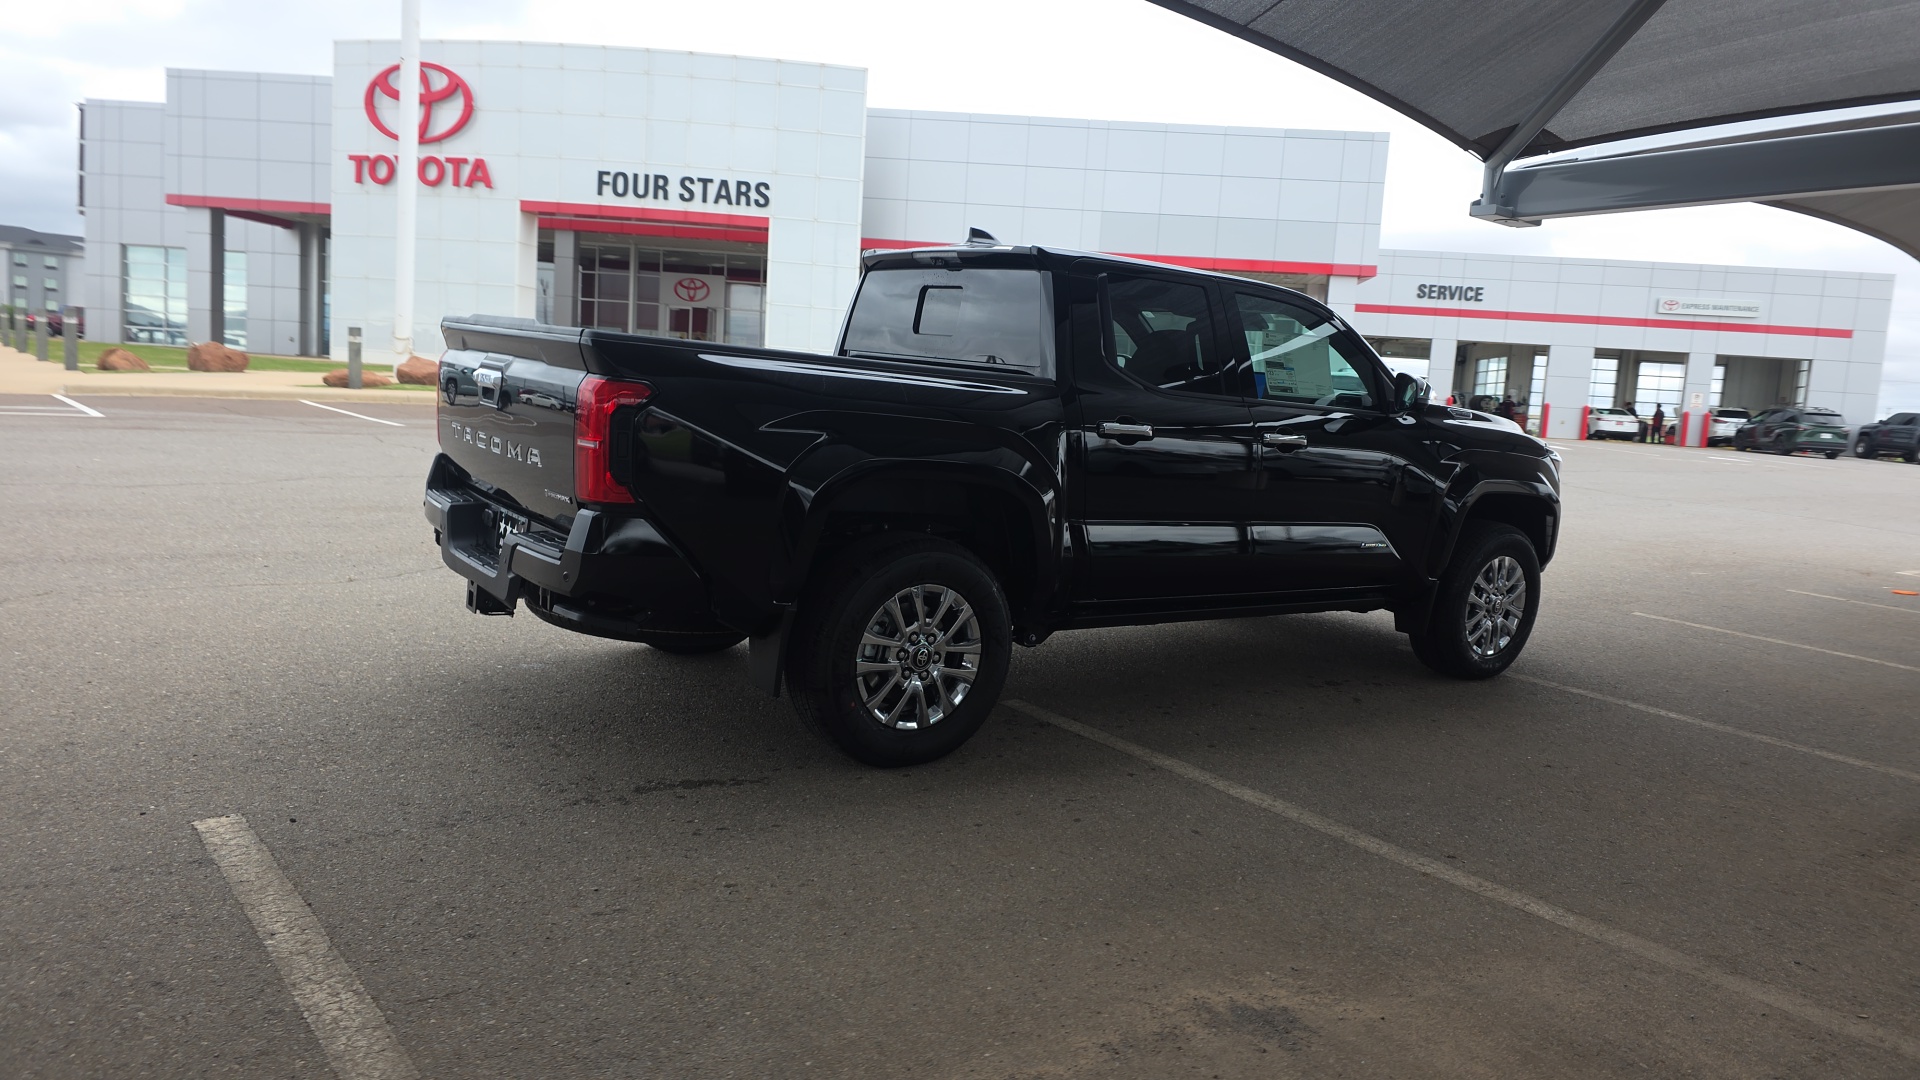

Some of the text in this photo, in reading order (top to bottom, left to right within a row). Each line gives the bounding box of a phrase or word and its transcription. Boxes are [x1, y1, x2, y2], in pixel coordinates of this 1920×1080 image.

[348, 154, 493, 188] TOOTA
[598, 171, 769, 207] FOUR STARS
[1416, 284, 1484, 302] SERVICE
[1681, 302, 1760, 312] EXPRESS MAINTENANCE
[451, 422, 542, 467] TACOMA
